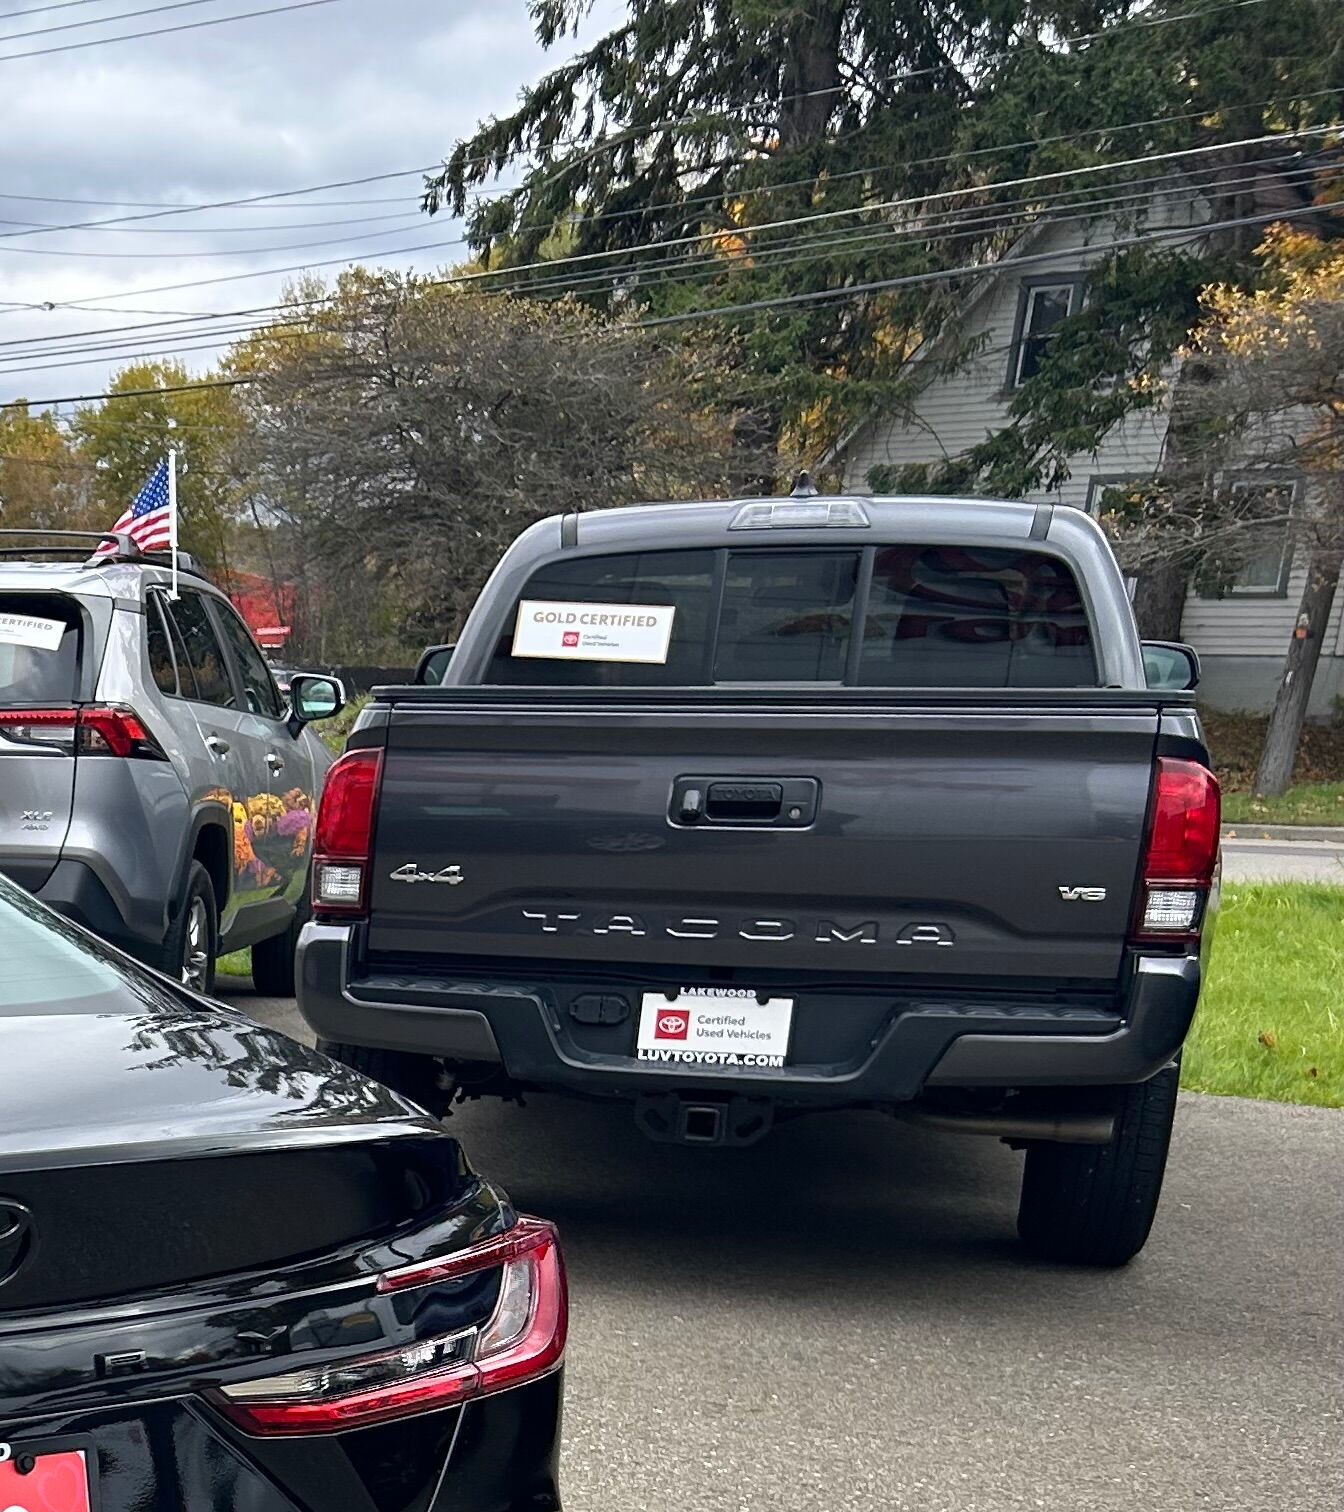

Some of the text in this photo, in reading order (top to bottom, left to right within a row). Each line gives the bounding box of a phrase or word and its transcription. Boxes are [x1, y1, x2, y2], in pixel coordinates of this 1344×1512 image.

[533, 611, 657, 628] GOLD CERTIFIED
[390, 863, 464, 885] 4x4
[1058, 886, 1107, 900] V6
[522, 909, 957, 946] TACOMA
[680, 986, 757, 998] LAKEWOOD
[697, 1014, 746, 1027] Certified
[696, 1028, 772, 1040] Used Vehicles
[637, 1048, 784, 1068] LUVTOYOTA.COM
